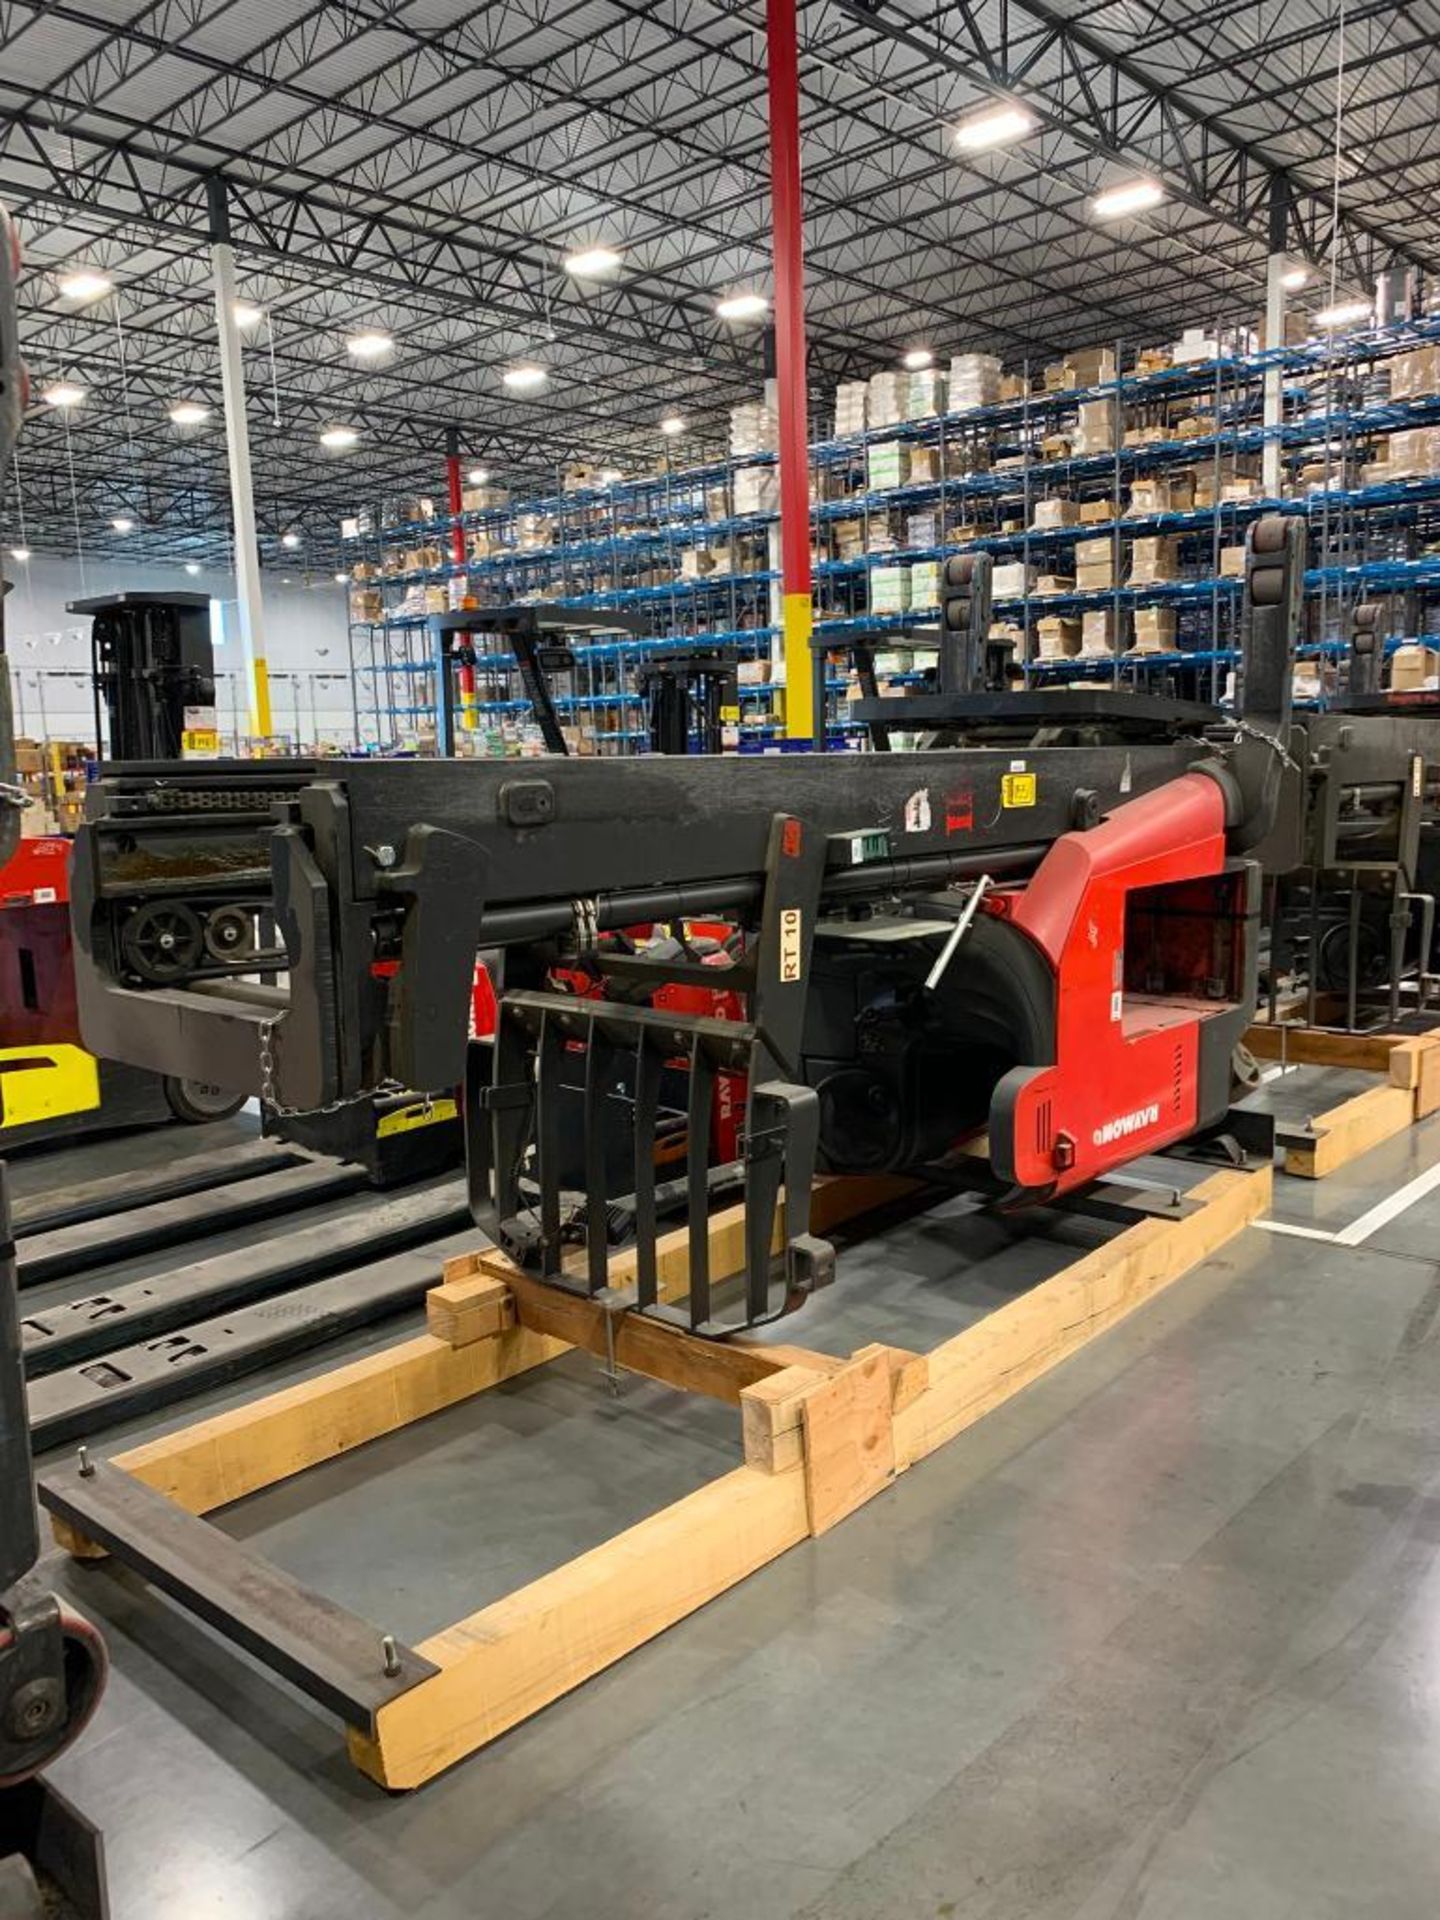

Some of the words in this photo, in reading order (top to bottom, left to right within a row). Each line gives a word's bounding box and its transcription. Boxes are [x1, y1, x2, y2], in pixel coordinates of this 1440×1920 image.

[784, 912, 797, 937] 10
[784, 947, 797, 979] RT
[1092, 1103, 1160, 1146] RAYMOND
